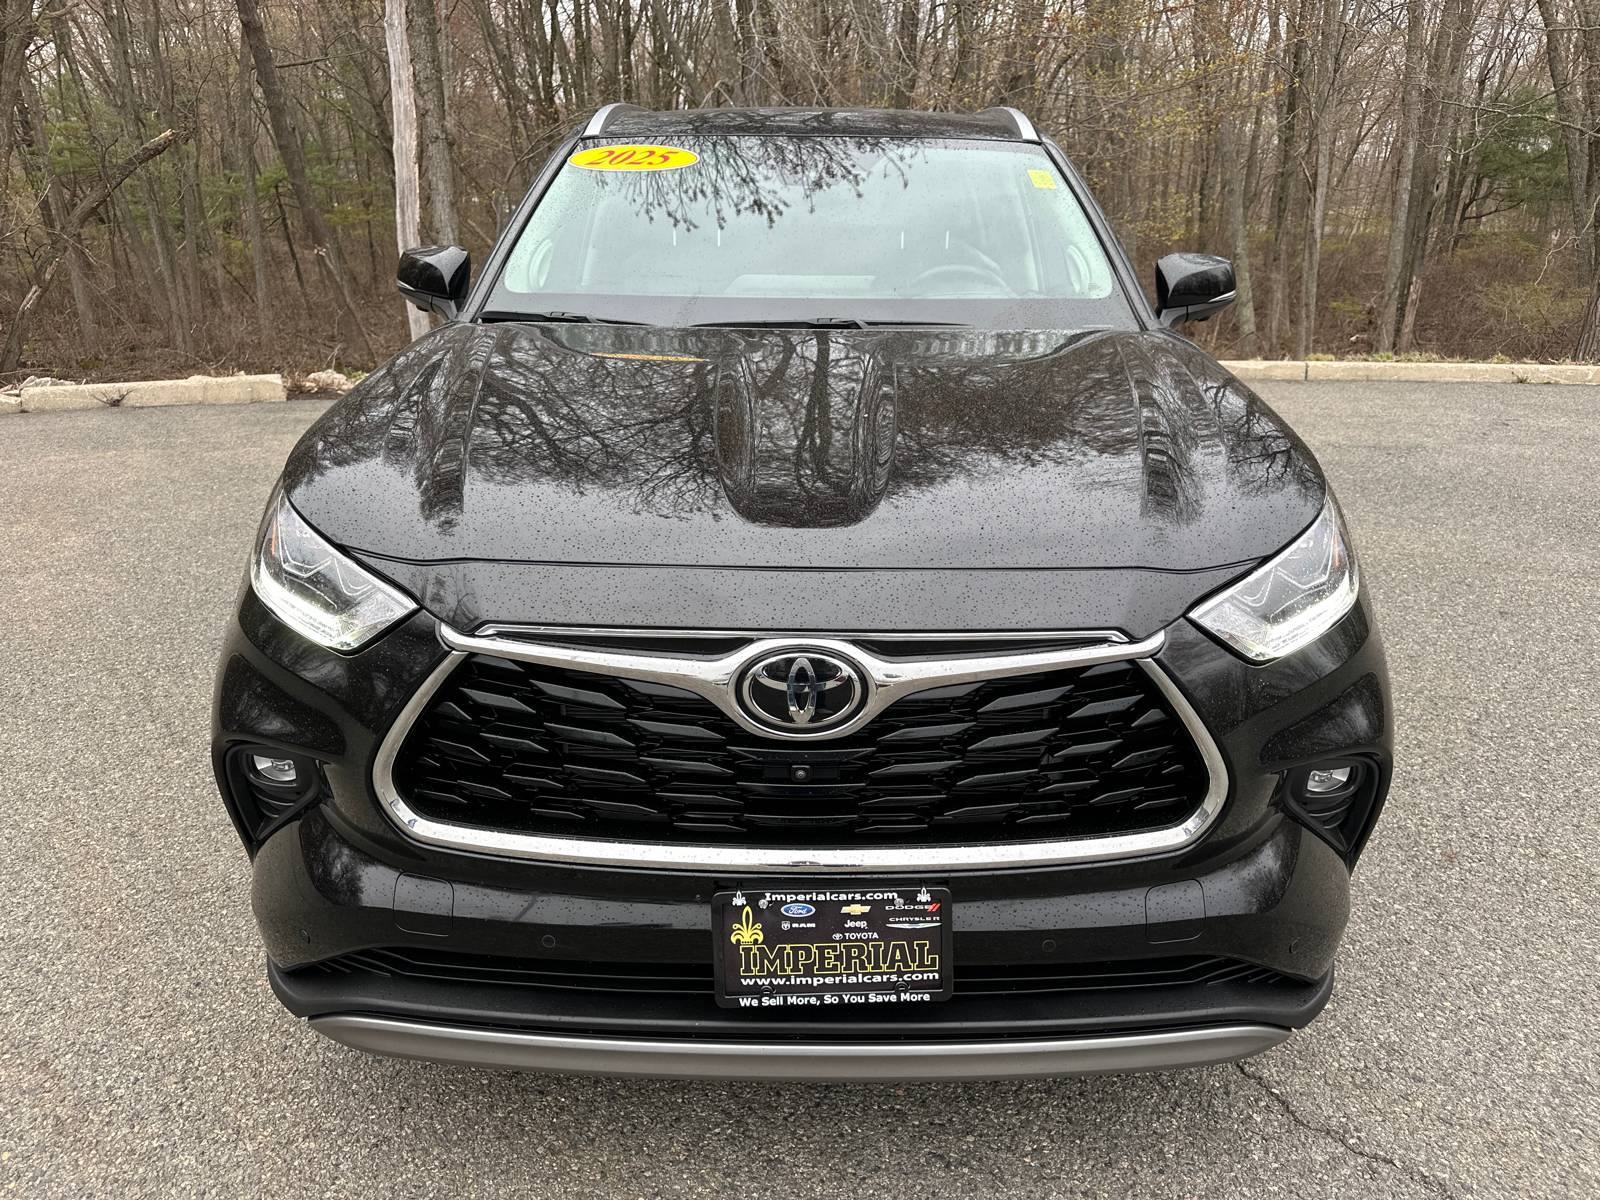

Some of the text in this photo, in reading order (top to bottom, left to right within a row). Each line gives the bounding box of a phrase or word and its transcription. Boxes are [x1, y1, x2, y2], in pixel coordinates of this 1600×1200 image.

[584, 150, 679, 166] 2025
[765, 892, 898, 903] Imperialcars.com
[788, 905, 808, 915] Ford
[844, 919, 868, 929] Jeep
[844, 932, 879, 940] TOYOTA
[739, 941, 939, 976] IMPERIAL
[740, 972, 939, 987] www.imperialcars.com
[739, 992, 931, 1007] We Sell More, So You Save More
